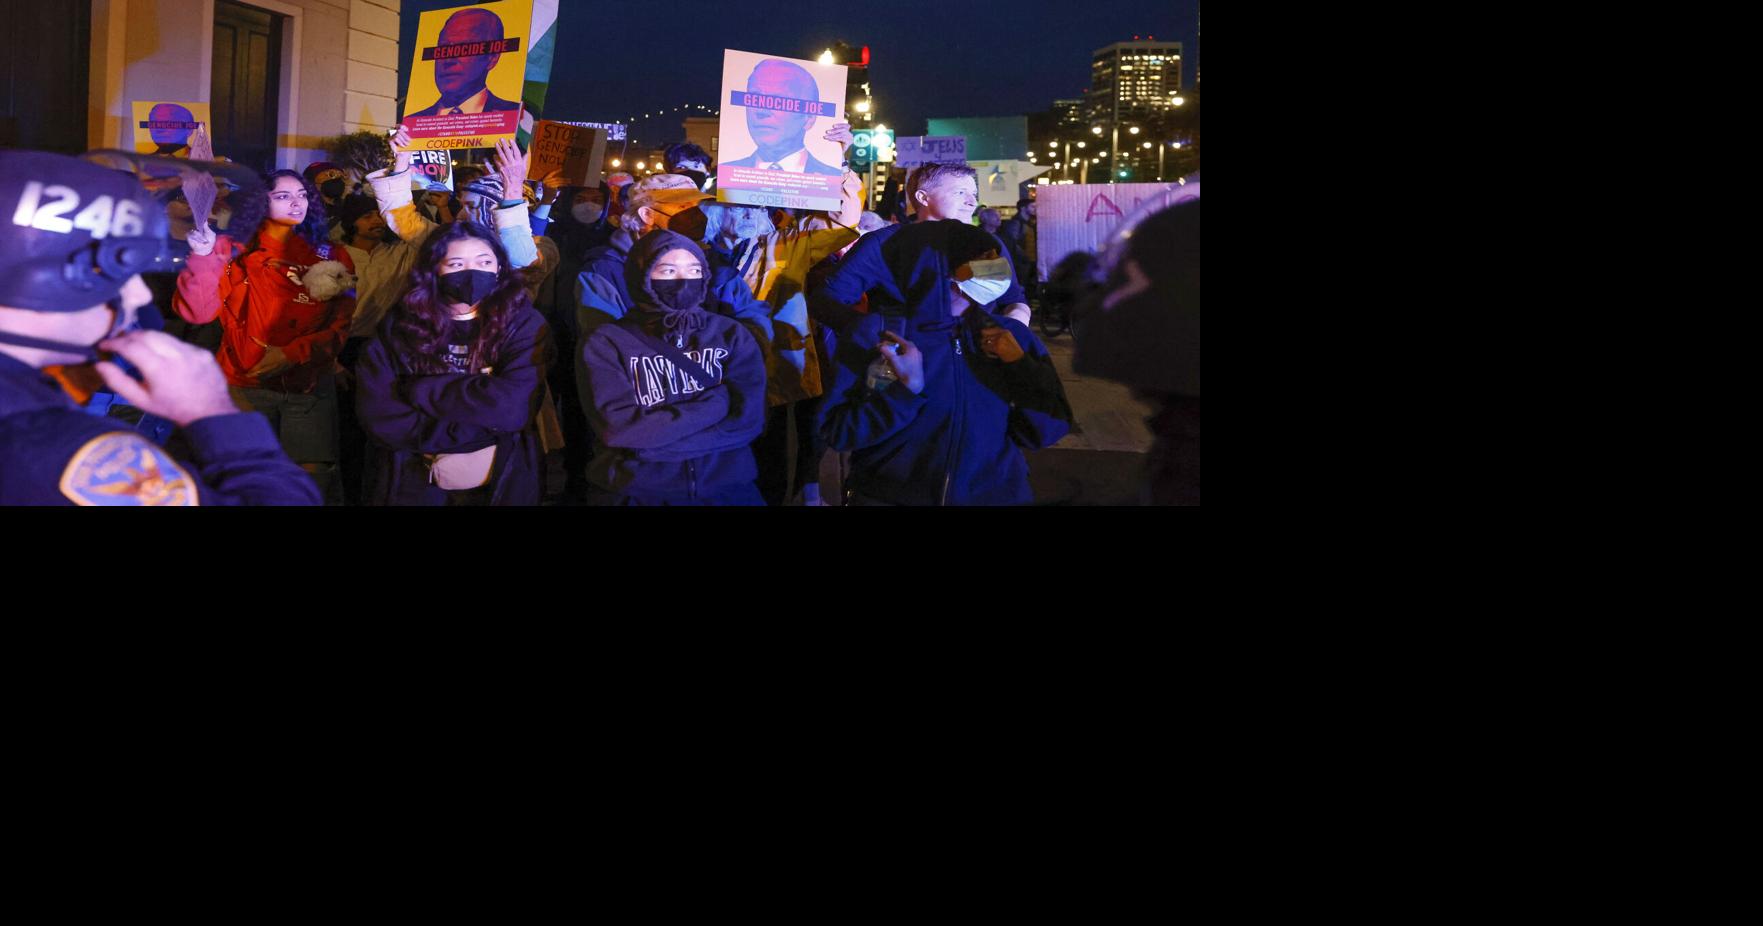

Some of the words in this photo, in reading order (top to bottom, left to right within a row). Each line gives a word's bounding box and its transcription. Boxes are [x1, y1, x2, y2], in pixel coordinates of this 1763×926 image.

[433, 42, 485, 59] GENOCIDE
[489, 40, 508, 53] JOE
[743, 93, 801, 111] GENOCIDE
[804, 101, 824, 114] JOE
[426, 138, 483, 149] CODEPINK
[410, 150, 447, 165] FIRE
[410, 164, 448, 177] NOW
[748, 193, 809, 208] CODEPINK
[12, 181, 144, 240] 1246
